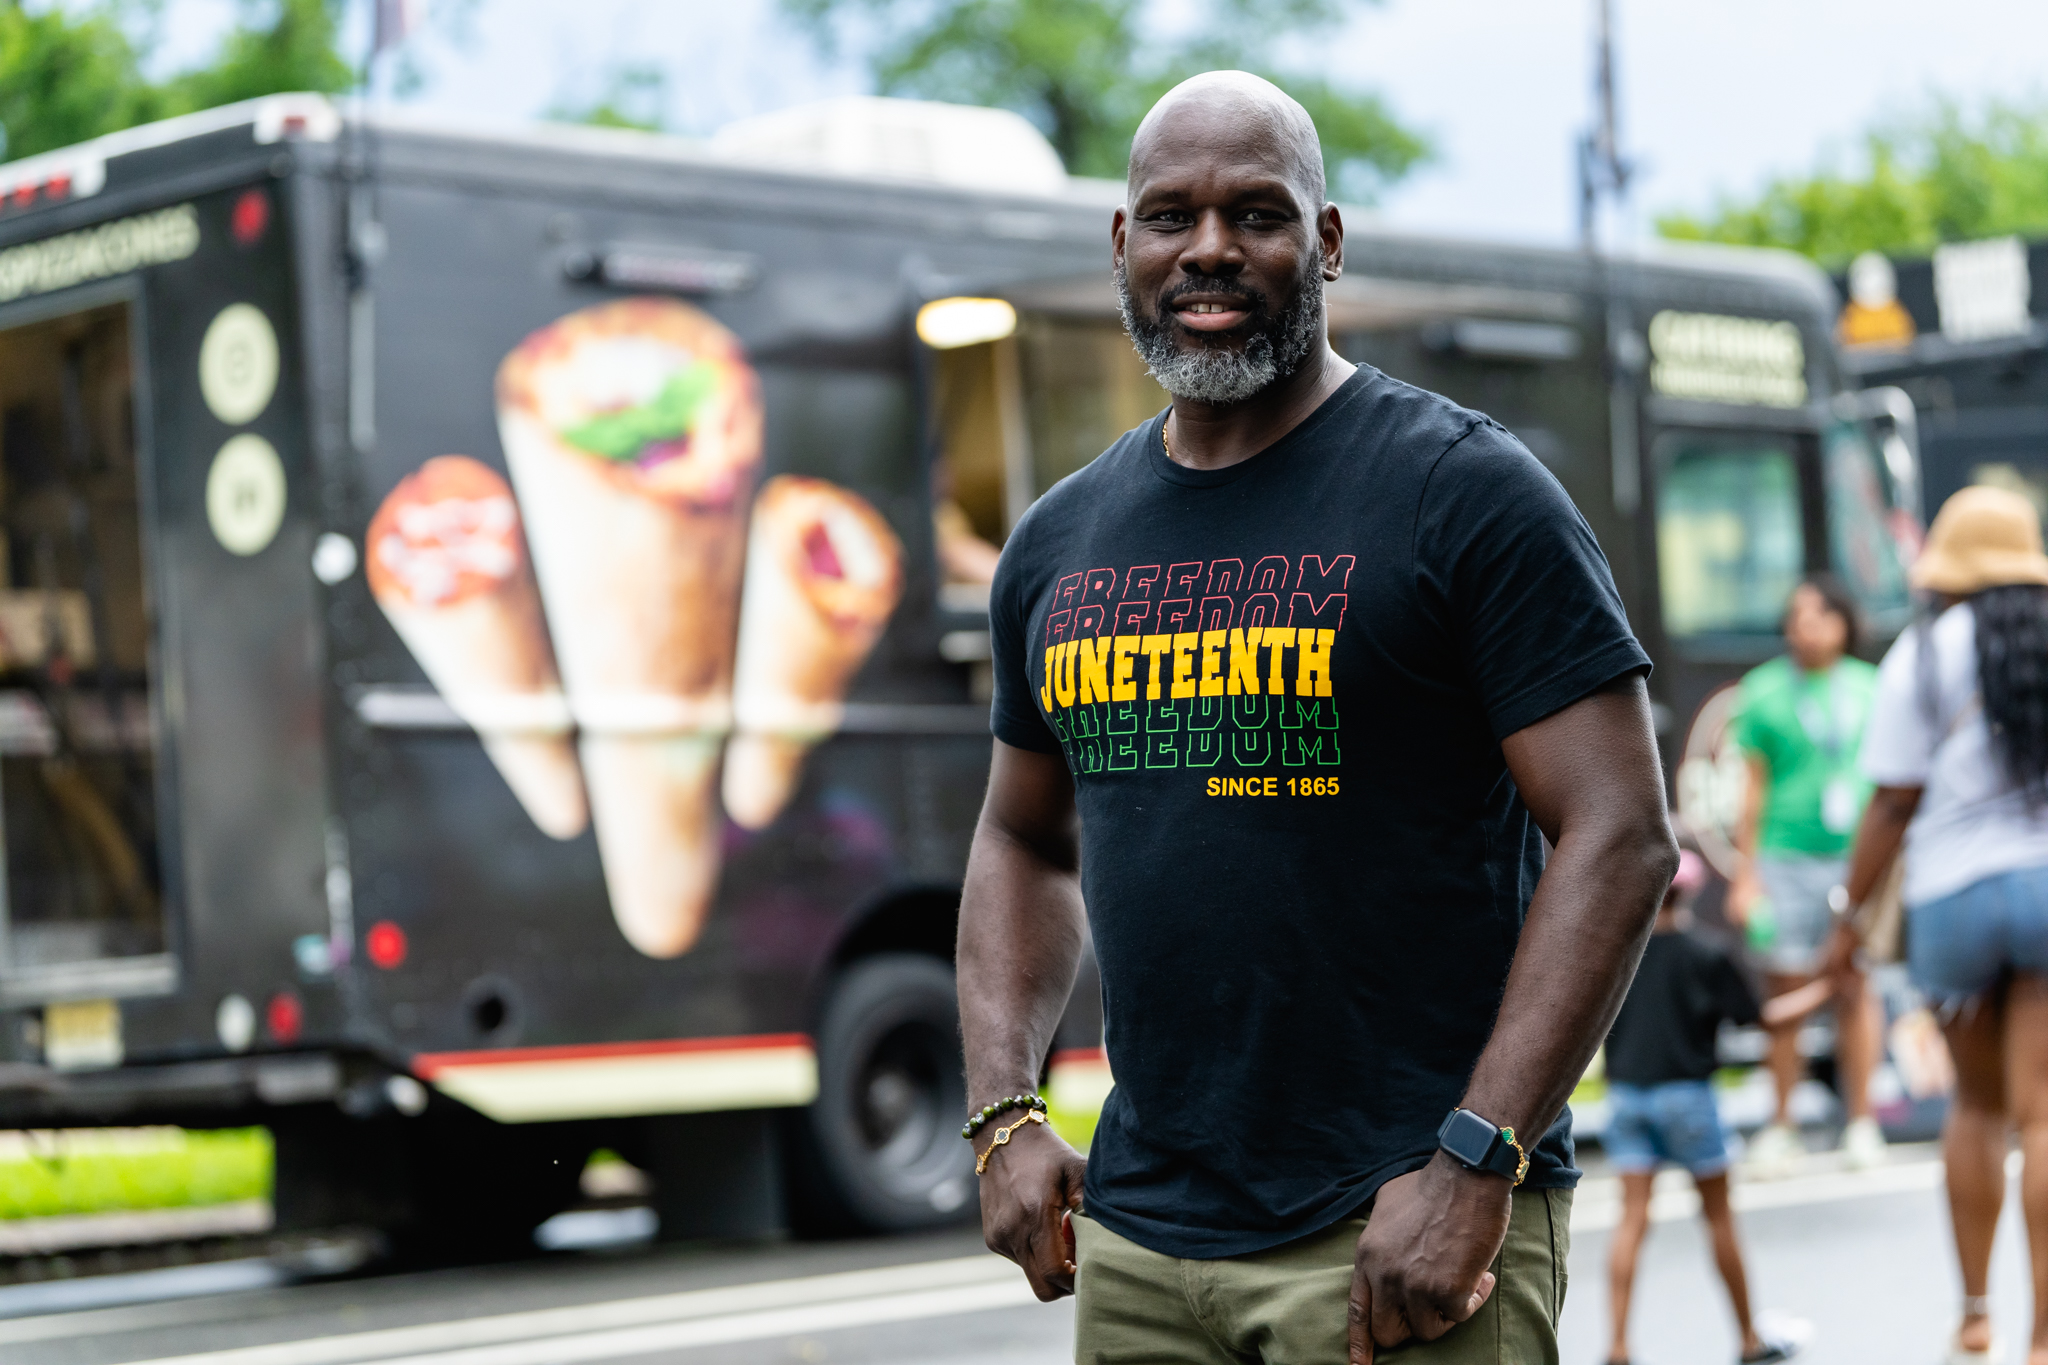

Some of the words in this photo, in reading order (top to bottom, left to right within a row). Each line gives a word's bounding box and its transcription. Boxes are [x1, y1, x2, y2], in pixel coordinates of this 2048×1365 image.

[1052, 554, 1356, 611] FREEDOM
[1045, 592, 1348, 649] FREEDOM
[1040, 626, 1335, 714] JUNETEENTH
[1066, 731, 1342, 776] REEDOM
[1206, 776, 1278, 797] SINCE
[1286, 776, 1341, 797] 1865
